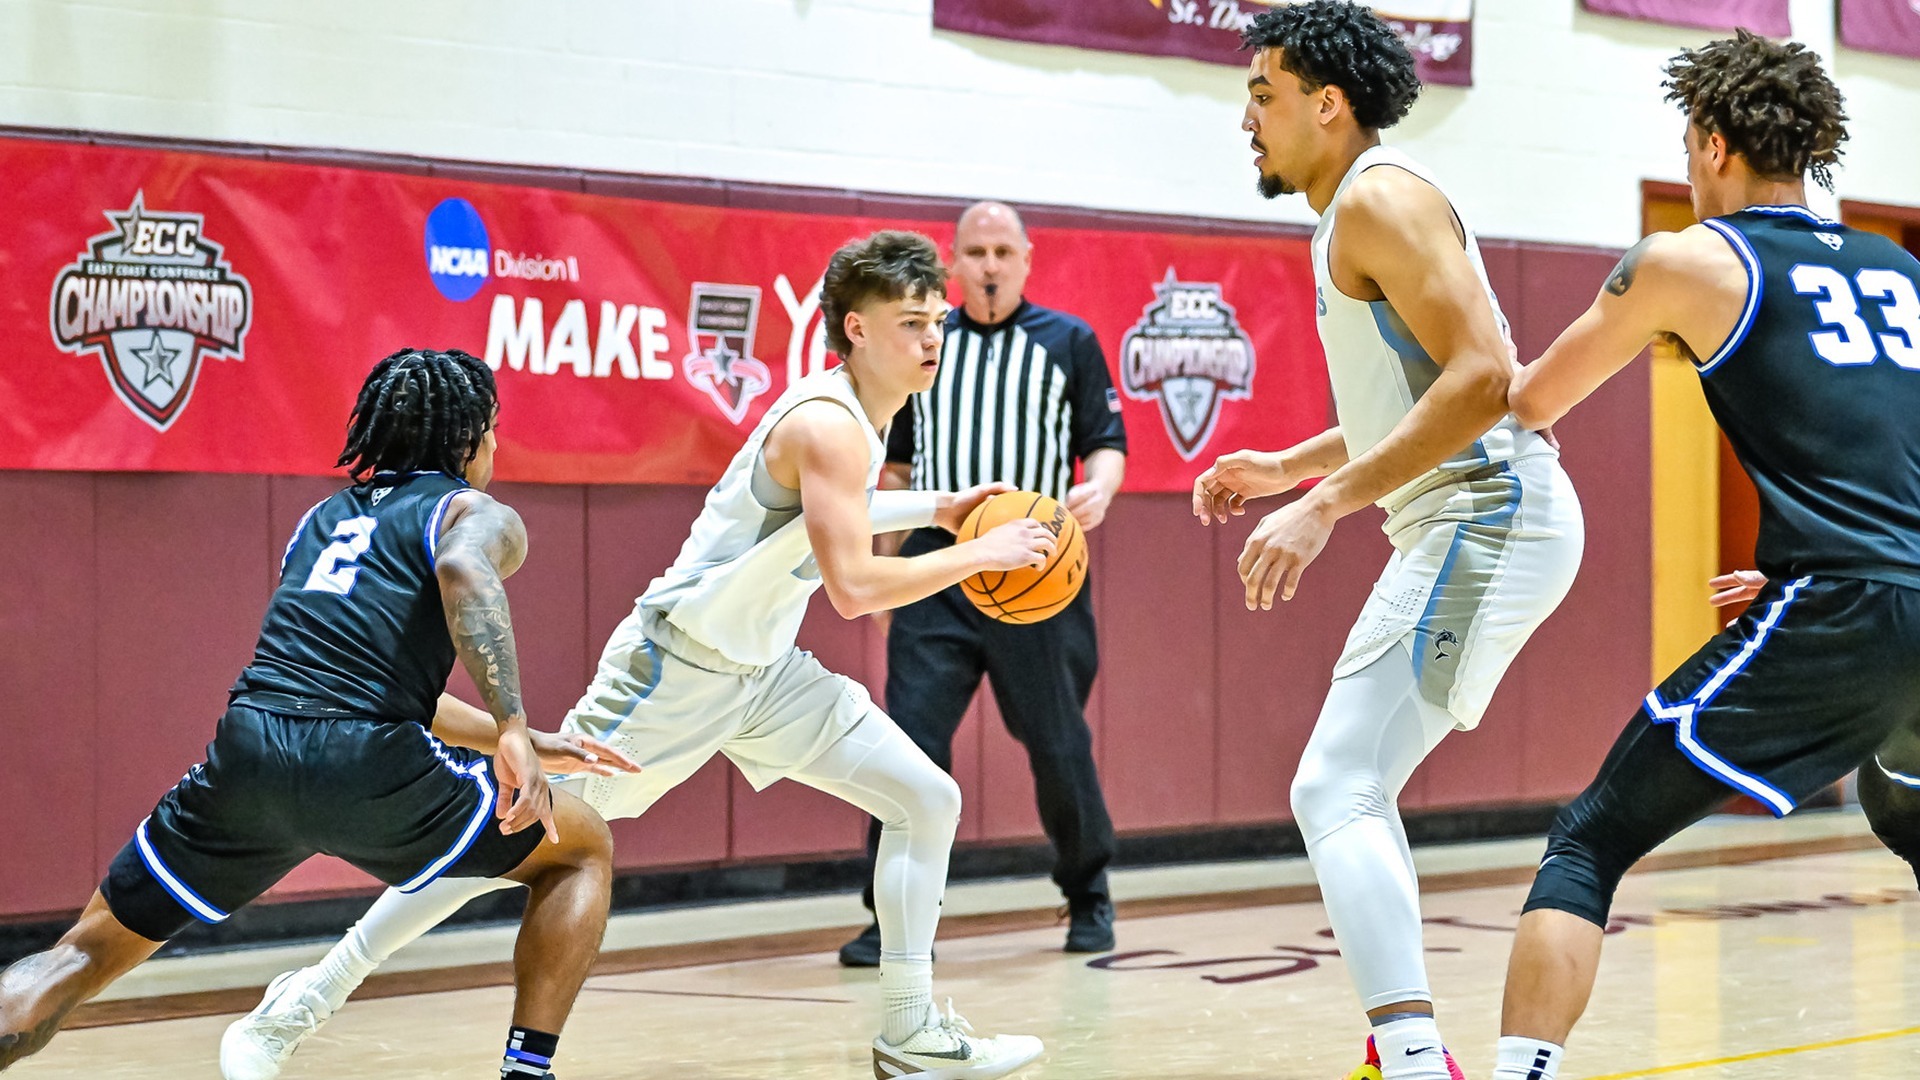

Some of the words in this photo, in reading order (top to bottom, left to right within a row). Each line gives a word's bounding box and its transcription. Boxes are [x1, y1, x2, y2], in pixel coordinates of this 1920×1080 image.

[132, 220, 197, 256] ECC
[87, 262, 114, 276] EAST
[115, 264, 148, 278] COAST
[430, 245, 490, 278] NCAA
[494, 249, 567, 281] Division
[59, 276, 244, 345] CHAMPIONSHIP
[1171, 290, 1219, 319] ECC
[1788, 263, 1920, 371] 33
[484, 293, 674, 380] MAKE
[302, 515, 379, 597] 2
